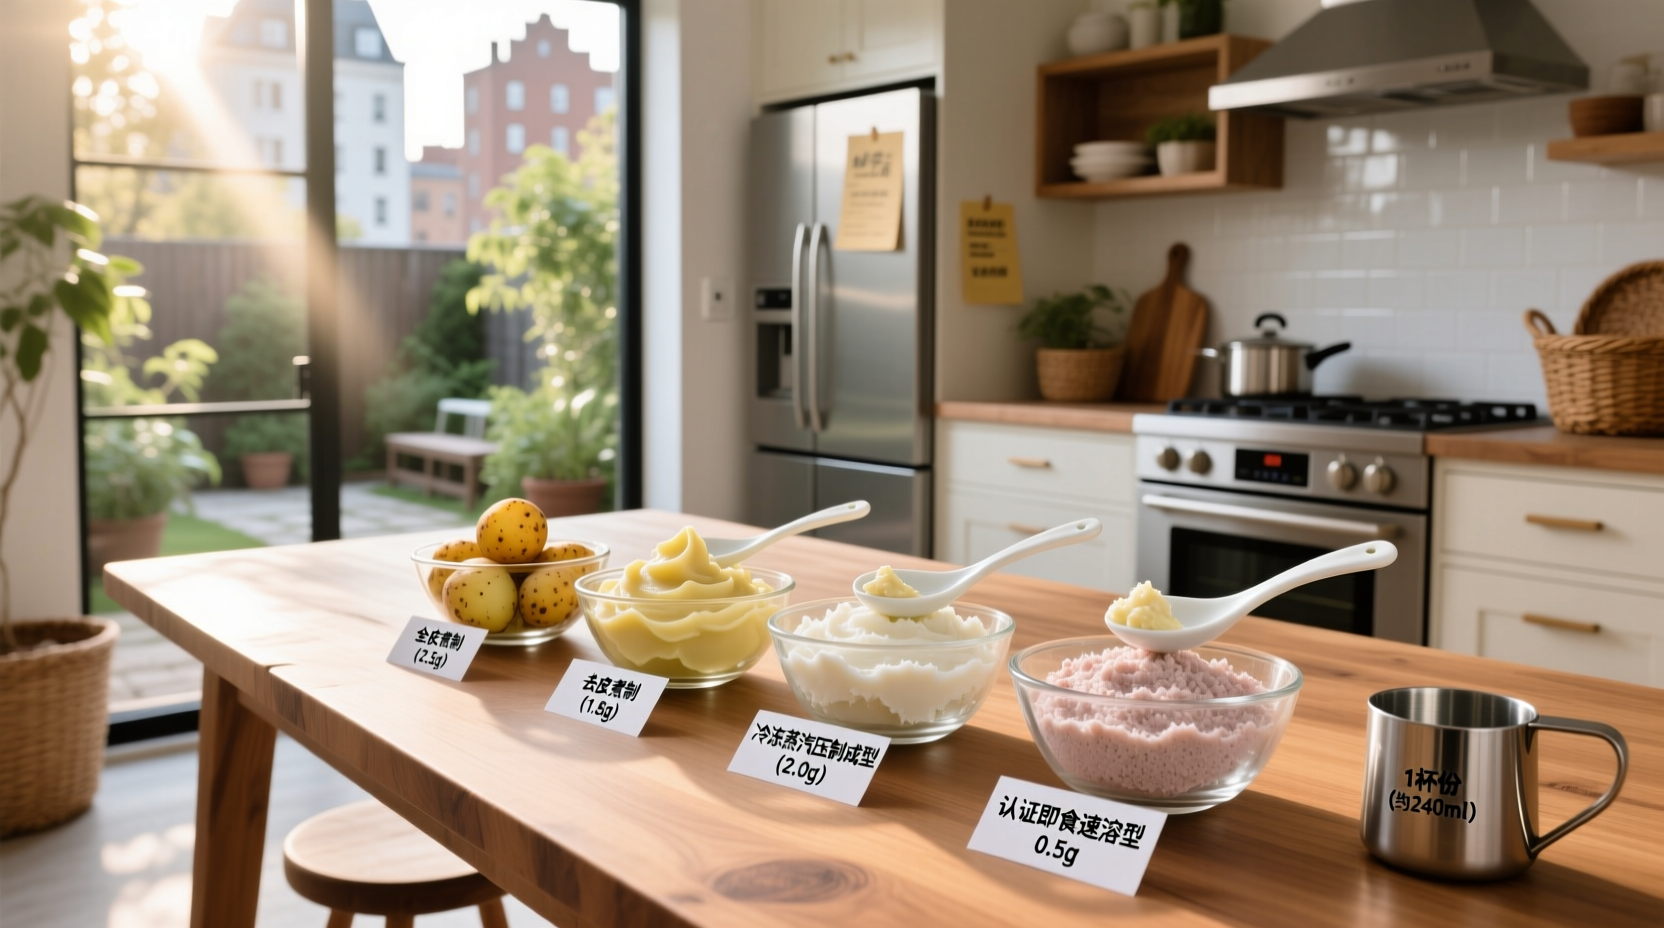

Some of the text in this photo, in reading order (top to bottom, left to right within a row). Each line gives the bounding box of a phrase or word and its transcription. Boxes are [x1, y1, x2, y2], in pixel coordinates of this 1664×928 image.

[413, 647, 448, 670] (2.5g)
[579, 695, 619, 722] (1.5g)
[751, 723, 881, 768] 冷冻蒸汽压制成型
[775, 754, 827, 786] (2.0g)
[1404, 767, 1462, 796] 1杯份
[998, 795, 1147, 849] 认证即食速溶型
[1034, 835, 1080, 867] 0.5g
